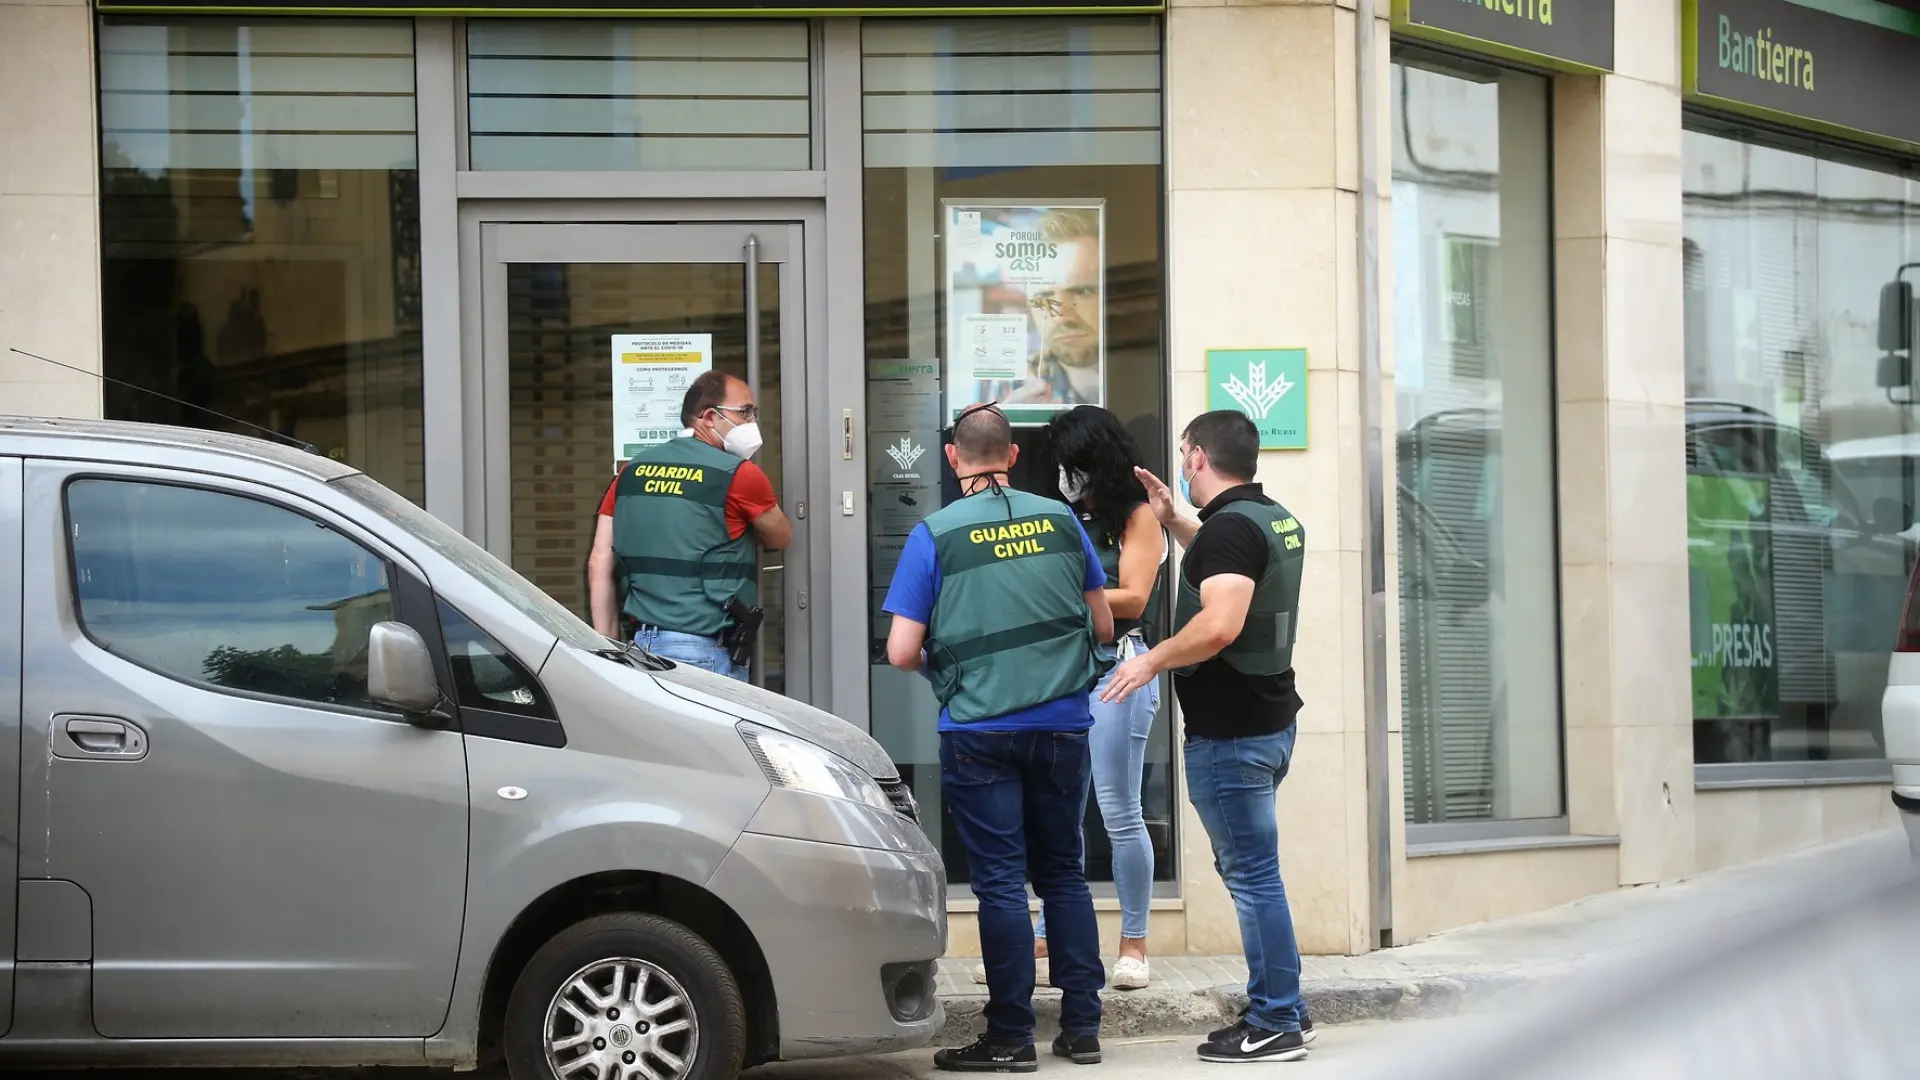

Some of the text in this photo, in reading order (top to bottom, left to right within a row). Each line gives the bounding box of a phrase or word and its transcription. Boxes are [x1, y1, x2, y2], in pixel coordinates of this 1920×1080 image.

[1719, 14, 1814, 91] Bantierra
[1010, 231, 1043, 241] PORQUE
[635, 465, 703, 483] GUARDIA
[644, 480, 683, 495] CIVIL
[969, 518, 1056, 544] GUARDIA
[1270, 516, 1300, 534] GUARDIA
[994, 538, 1045, 559] CIVIL
[1284, 533, 1302, 550] CIVIL
[1690, 623, 1772, 668] PRESAS
